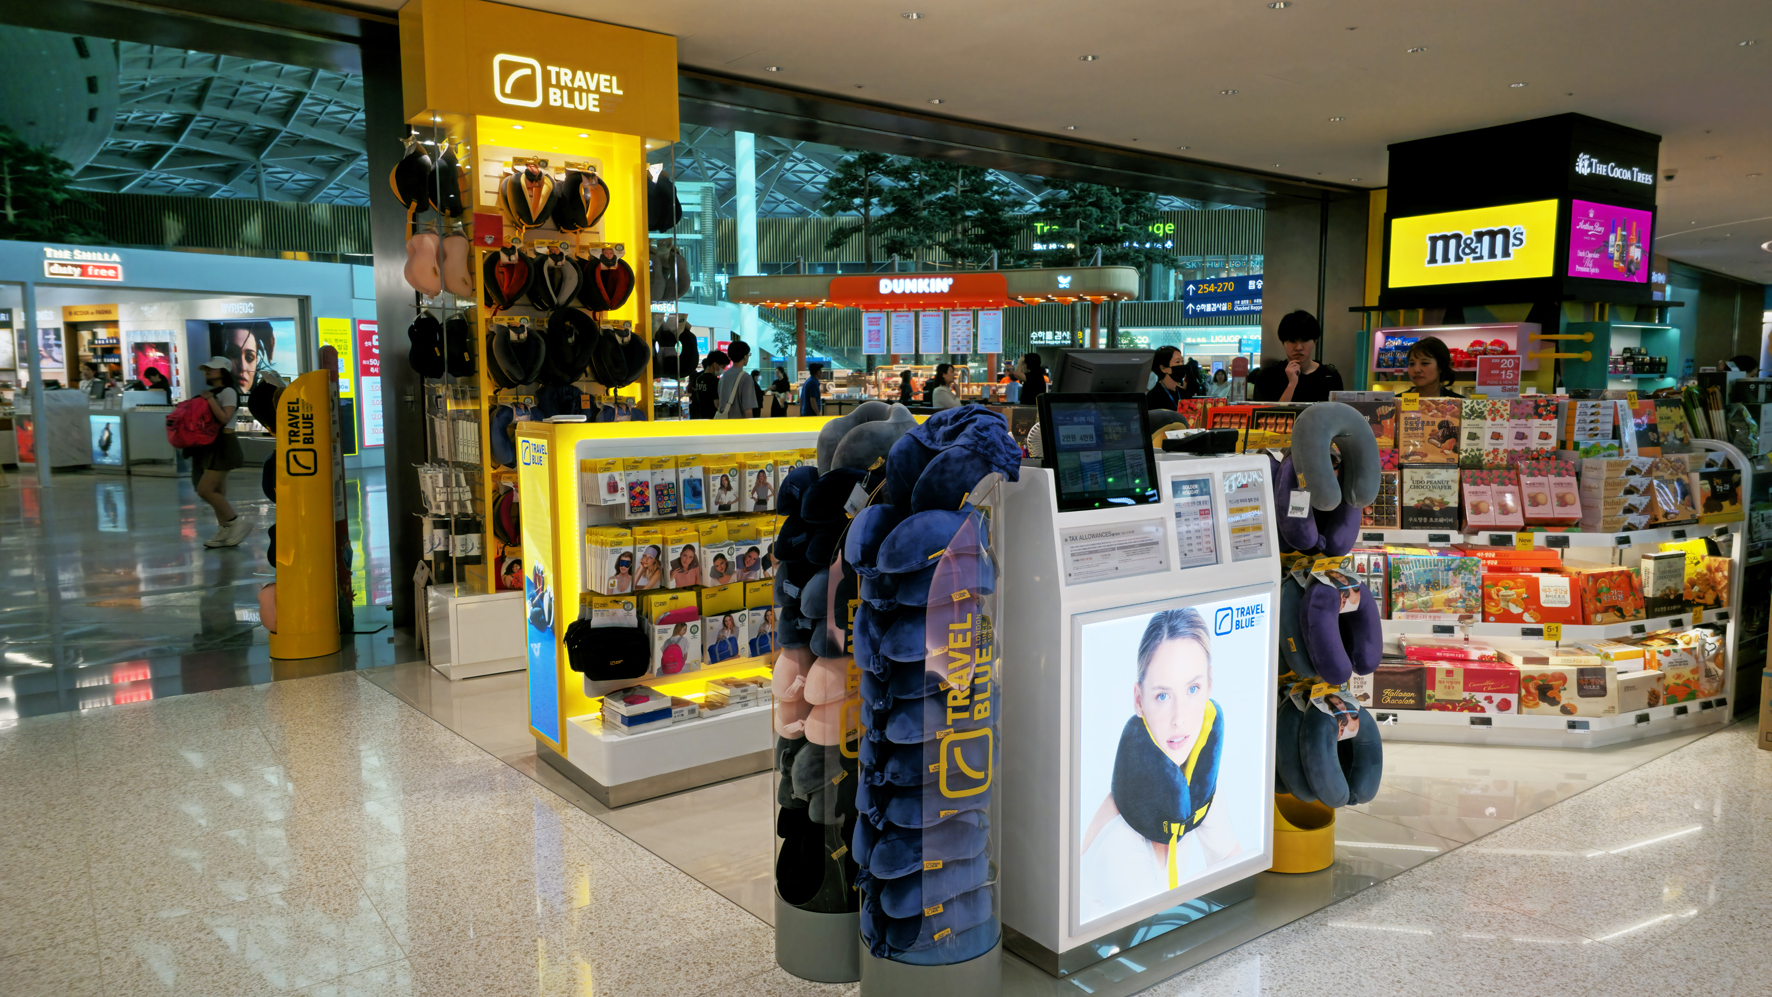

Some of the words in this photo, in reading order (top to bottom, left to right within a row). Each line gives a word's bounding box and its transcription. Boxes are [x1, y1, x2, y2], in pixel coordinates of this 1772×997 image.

[546, 66, 623, 95] TRAVEL
[548, 87, 600, 112] BLUE
[1591, 158, 1606, 175] THE
[1608, 162, 1632, 180] COCOA
[1632, 167, 1653, 184] TREES
[1426, 227, 1524, 265] m&m's
[44, 247, 72, 260] THE
[73, 249, 121, 262] SHILLA
[50, 263, 82, 277] duty
[87, 266, 117, 277] free
[879, 278, 953, 294] DUNKIN'
[1198, 282, 1234, 293] 254-270
[1228, 302, 1232, 310] B
[1030, 331, 1053, 340] 수하물
[1054, 331, 1071, 340] 검사
[1500, 359, 1514, 368] 20
[1500, 370, 1513, 379] 15
[287, 398, 300, 445] TRAVEL
[302, 413, 314, 444] BLUE
[1062, 434, 1076, 442] 2만원
[531, 443, 547, 455] TRAVEL
[532, 455, 542, 465] BLUE
[1606, 460, 1624, 468] Dubai
[1604, 479, 1622, 487] Dubai
[1603, 499, 1621, 507] Dubai
[1079, 531, 1111, 541] ALLOWANCES
[1236, 604, 1264, 618] TRAVEL
[1235, 617, 1255, 630] BLUE
[947, 613, 972, 725] TRAVEL
[974, 646, 992, 720] BLUE
[1382, 689, 1416, 697] Hallasan
[1382, 696, 1415, 704] Chocolate
